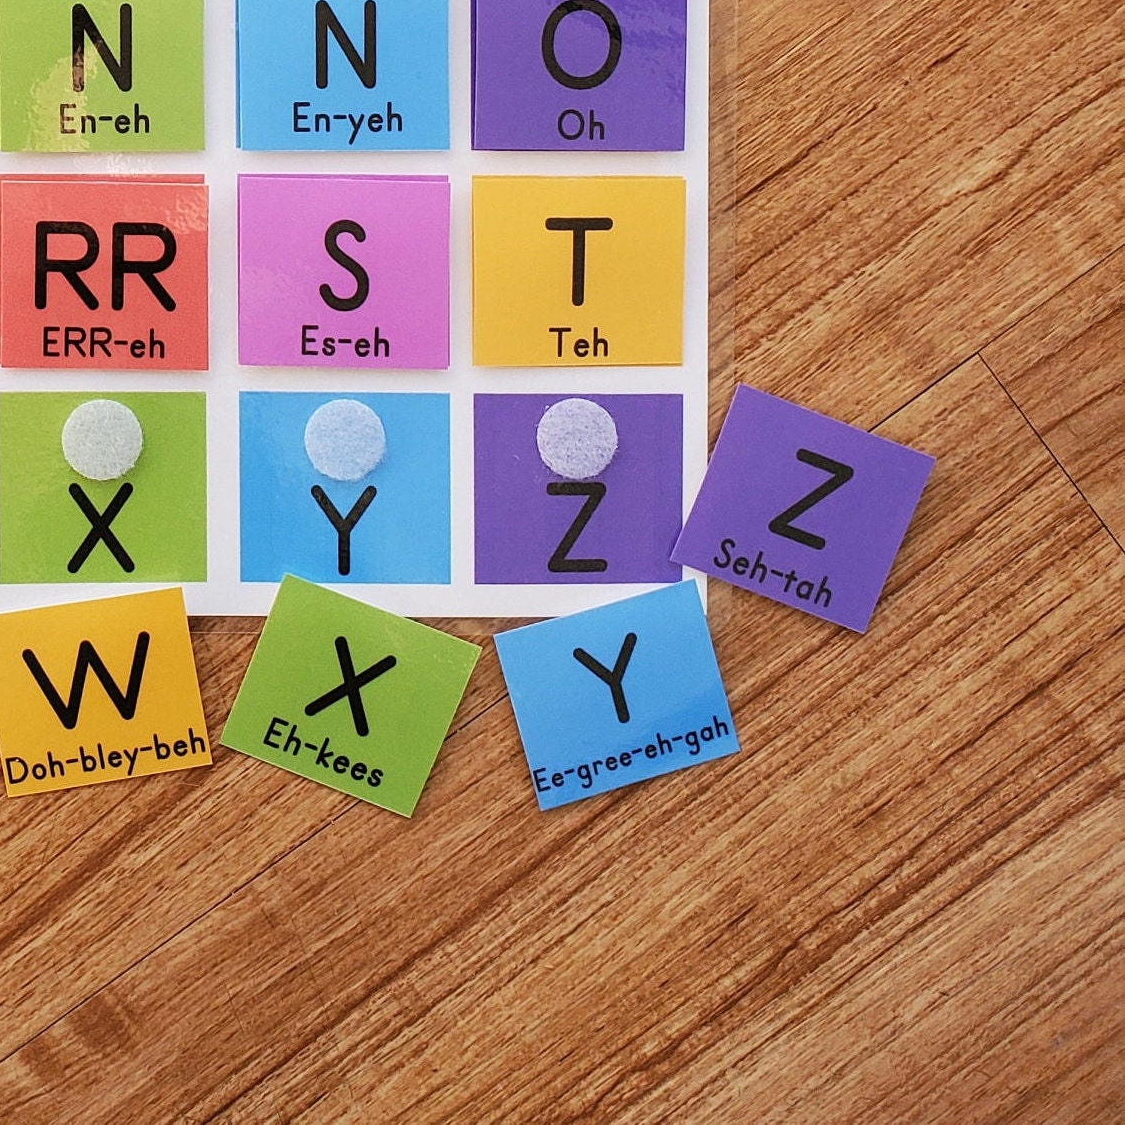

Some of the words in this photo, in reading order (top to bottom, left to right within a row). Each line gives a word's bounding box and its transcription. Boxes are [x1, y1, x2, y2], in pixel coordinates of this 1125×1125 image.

[71, 3, 133, 93] N
[59, 102, 150, 134] En-eh
[293, 101, 403, 145] En-yeh
[557, 108, 604, 141] Oh
[34, 220, 177, 312] RR
[319, 219, 370, 312] S
[545, 217, 614, 307] T
[42, 326, 165, 359] ERR-eh
[301, 324, 390, 358] Es-eh
[548, 326, 609, 358] Teh
[67, 482, 135, 574] X
[310, 484, 378, 576] Y
[546, 480, 608, 573] Z
[768, 448, 854, 551] Z
[713, 537, 833, 610] Seh-tah
[21, 631, 151, 730] W
[304, 636, 397, 738] X
[572, 632, 638, 724] Y
[4, 727, 207, 785] Doh-bley-beh
[262, 716, 385, 788] Eh-kees
[531, 714, 730, 793] Ee-gree-eh-gah
